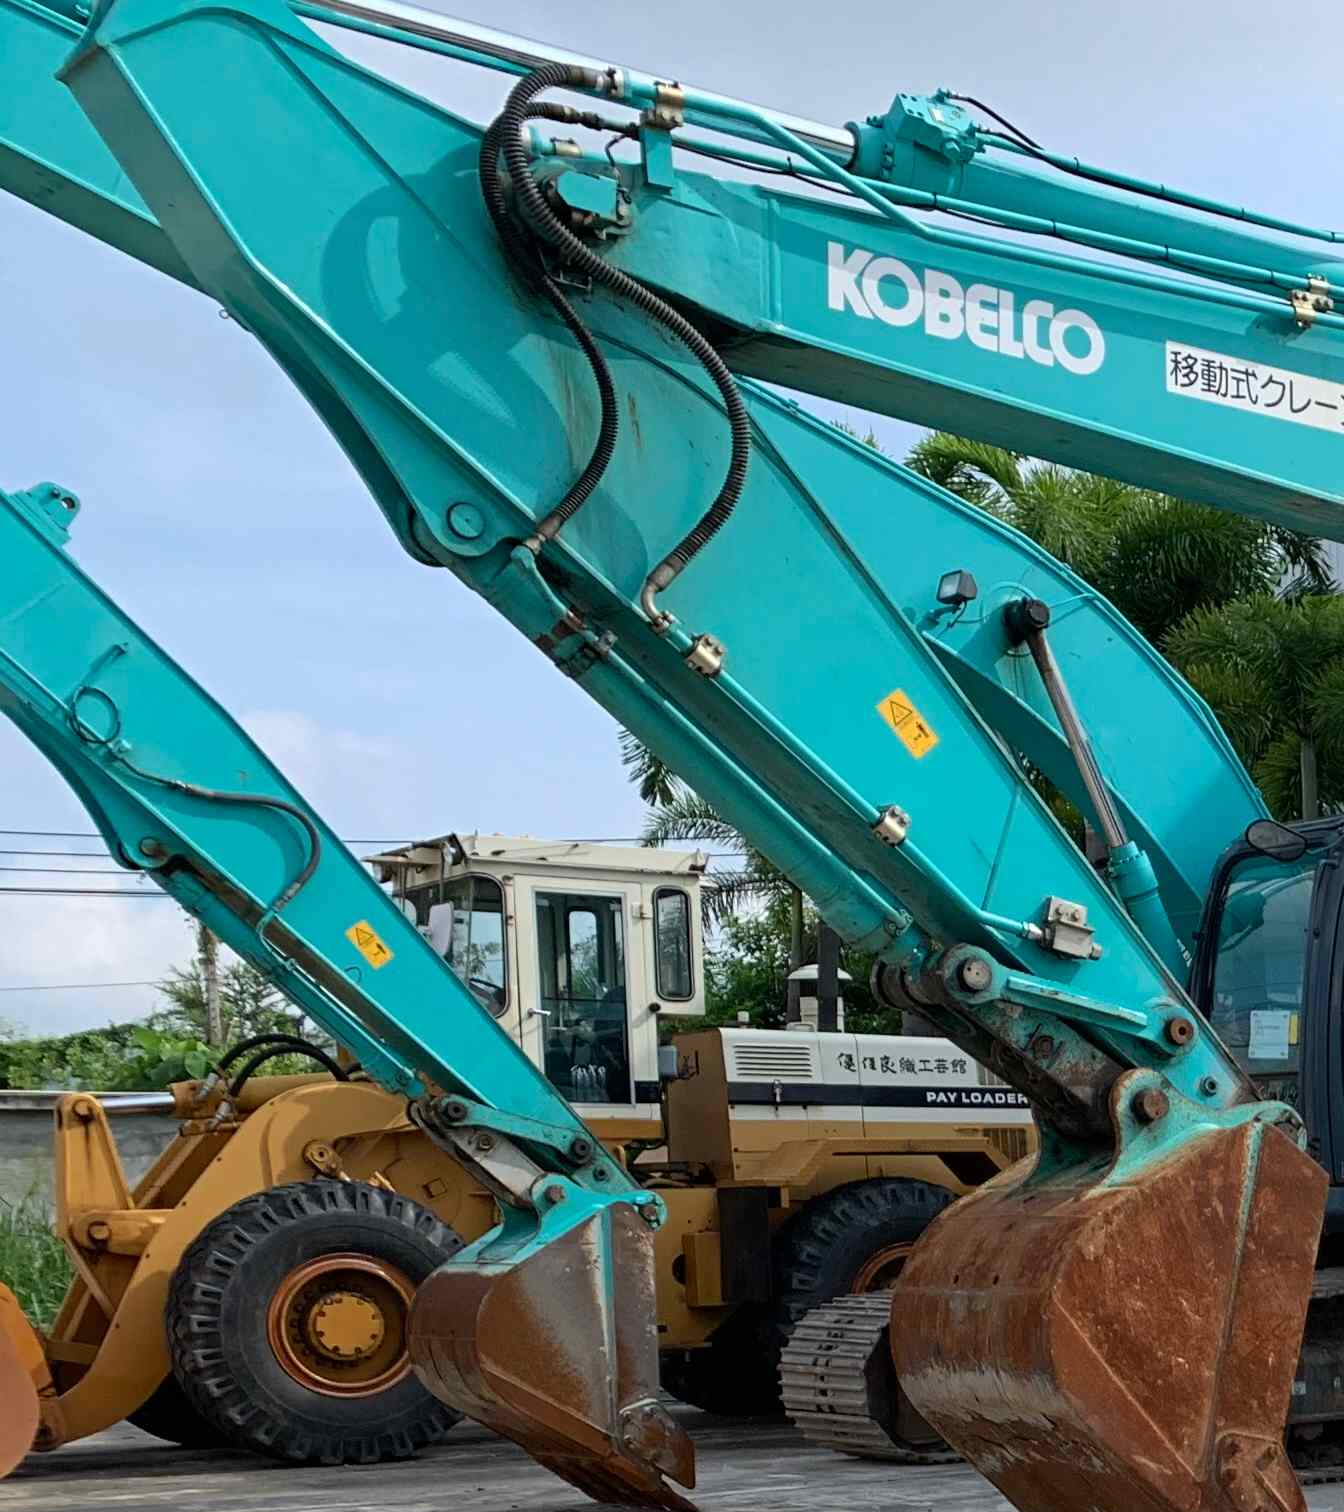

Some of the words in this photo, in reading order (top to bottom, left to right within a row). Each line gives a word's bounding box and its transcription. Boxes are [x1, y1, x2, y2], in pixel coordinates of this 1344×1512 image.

[826, 241, 1106, 376] KOBELCO
[926, 1091, 958, 1103] PAY
[961, 1092, 1029, 1105] LOADER
